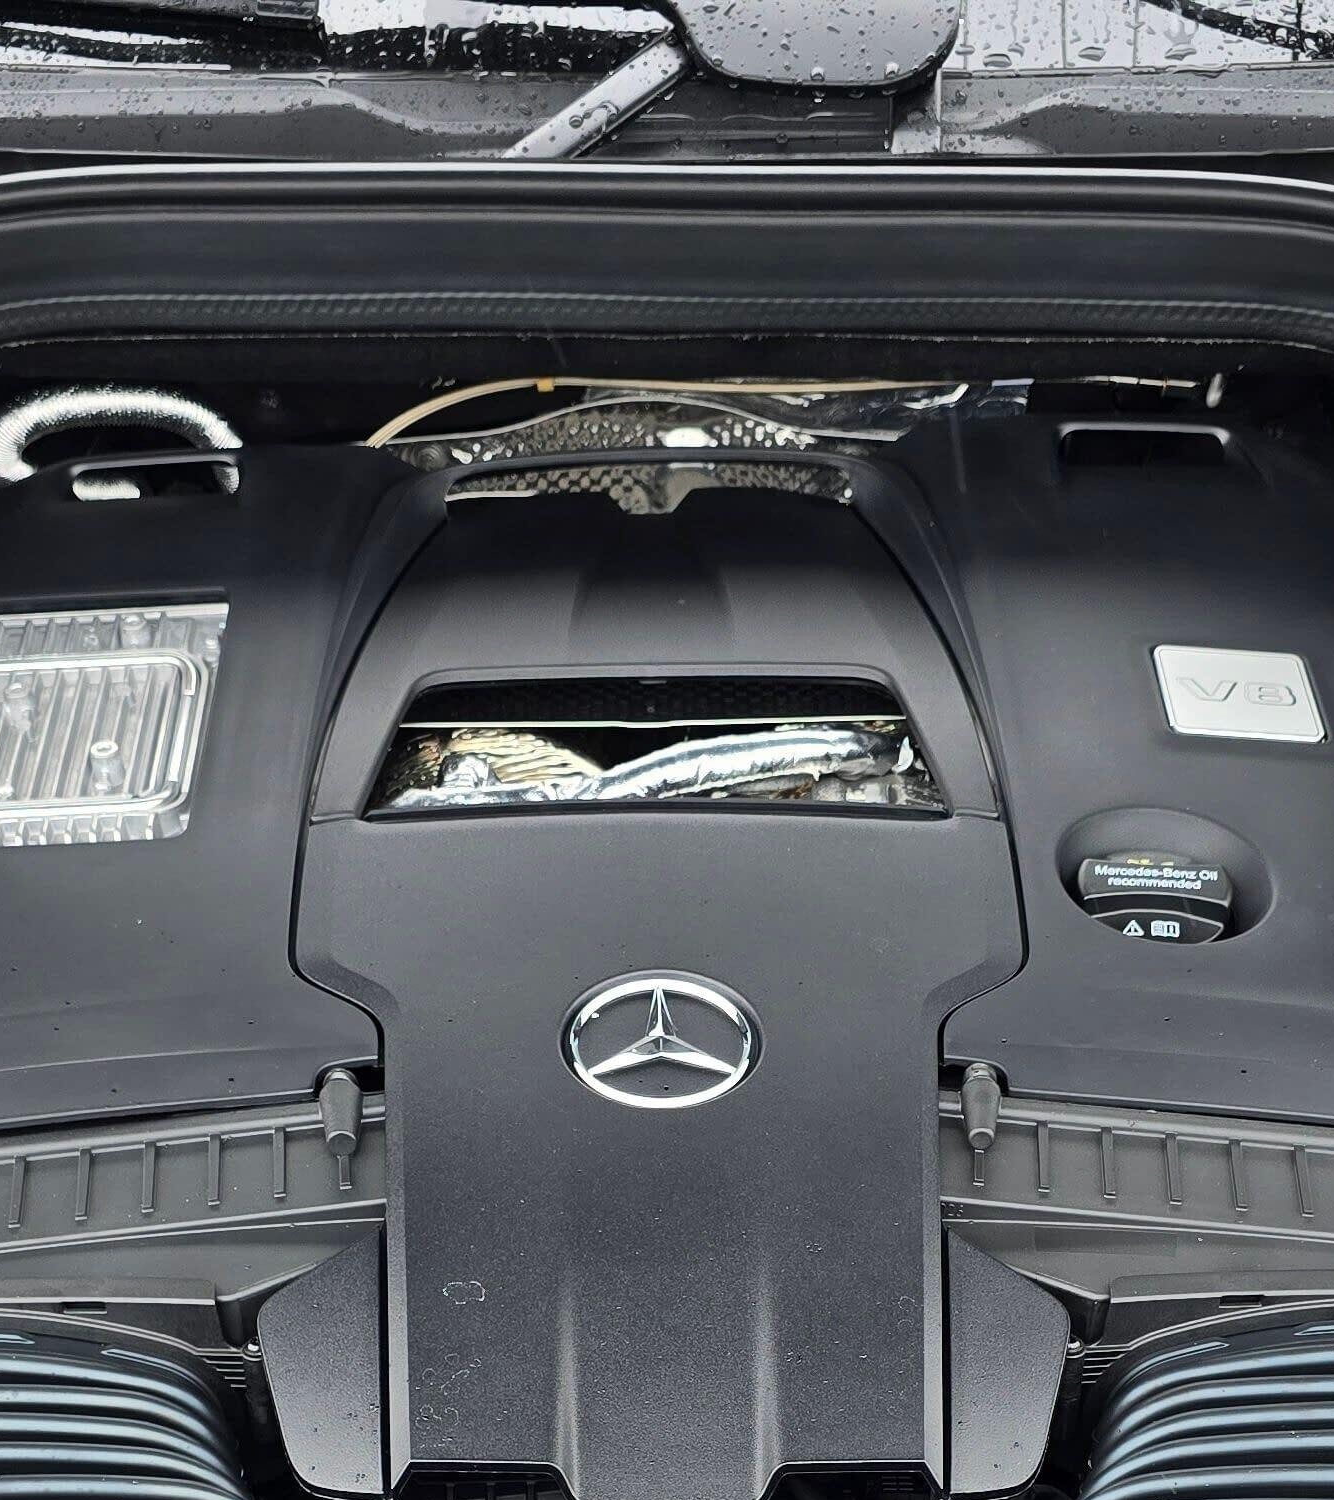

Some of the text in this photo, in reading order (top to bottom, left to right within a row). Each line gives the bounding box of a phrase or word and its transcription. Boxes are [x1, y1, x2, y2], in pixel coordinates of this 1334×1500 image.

[1175, 677, 1297, 707] V8
[1094, 864, 1218, 882] Mercedes-Benz Oil
[1107, 876, 1202, 890] recommended
